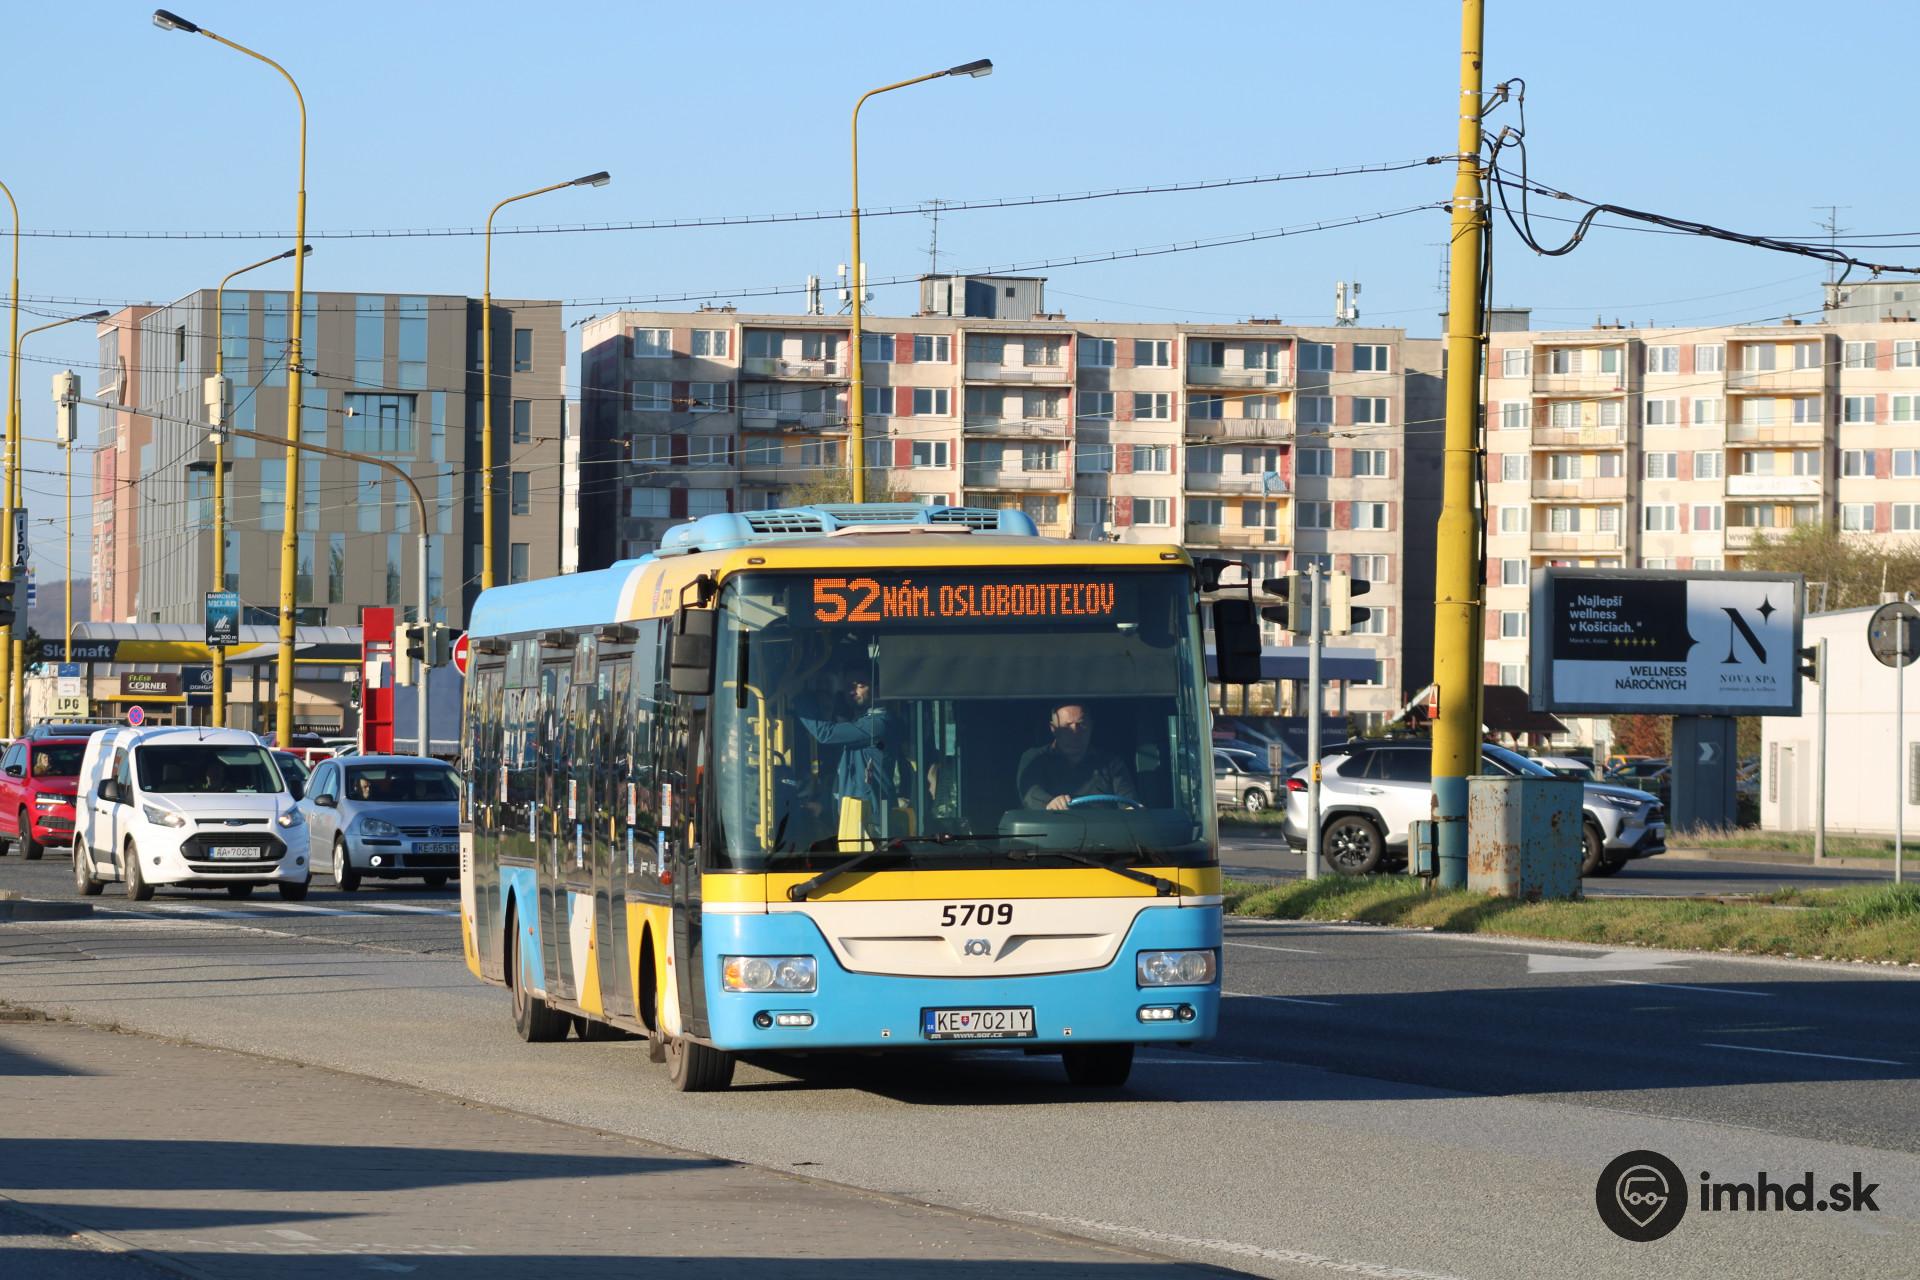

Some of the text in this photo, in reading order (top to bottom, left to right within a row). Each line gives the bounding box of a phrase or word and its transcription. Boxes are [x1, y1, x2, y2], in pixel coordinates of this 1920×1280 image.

[813, 578, 1115, 622] 52 NÁM. OSLOBODITEĽOV
[1569, 608, 1617, 619] wellness
[1569, 623, 1576, 631] v
[1630, 666, 1688, 676] WELLNESS
[1615, 677, 1688, 690] NÁROČNÝCH
[1720, 673, 1777, 684] NOVA SPA
[128, 682, 167, 690] CORNER
[58, 698, 80, 710] LPG
[941, 903, 1013, 927] 5709
[937, 1013, 960, 1030] KE
